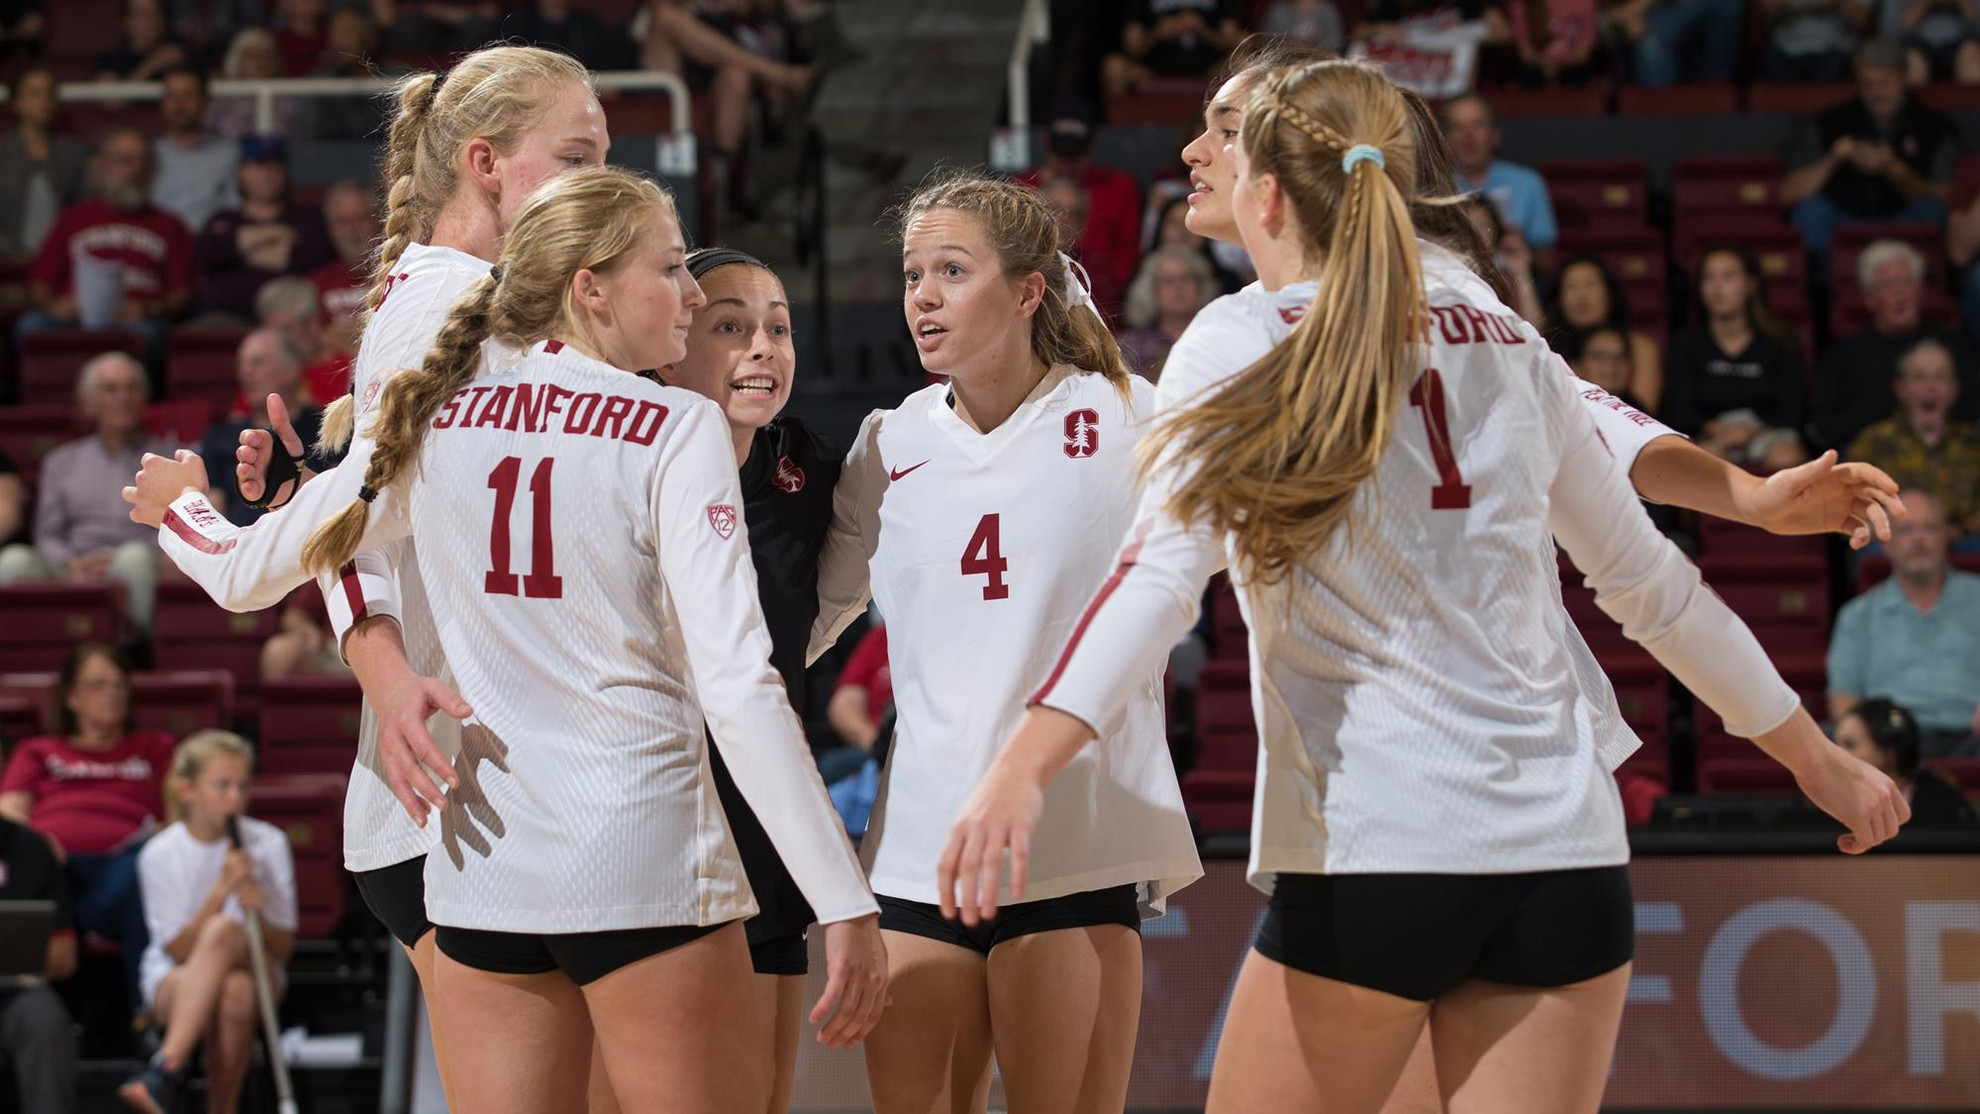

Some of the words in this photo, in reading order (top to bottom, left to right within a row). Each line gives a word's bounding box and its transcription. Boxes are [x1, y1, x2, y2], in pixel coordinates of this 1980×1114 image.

[432, 383, 670, 447] STANFORD
[1409, 368, 1472, 510] 1
[484, 455, 563, 600] 11
[717, 519, 731, 532] 12
[960, 512, 1010, 602] 4
